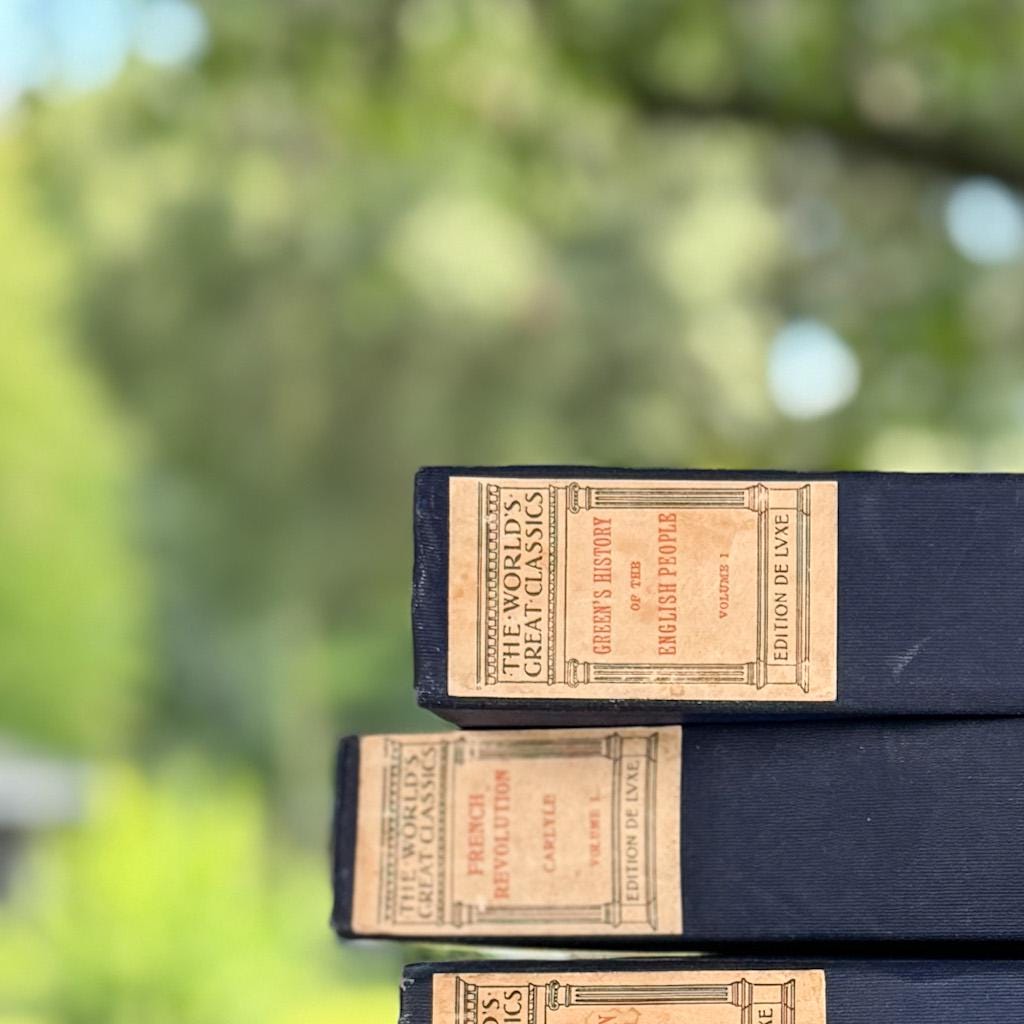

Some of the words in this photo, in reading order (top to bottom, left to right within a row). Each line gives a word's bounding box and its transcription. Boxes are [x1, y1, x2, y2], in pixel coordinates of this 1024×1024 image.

[525, 491, 543, 596] CLASSICS
[593, 517, 612, 583] HISTORY
[659, 512, 677, 576] PEOPLE
[773, 563, 789, 585] DE
[592, 589, 612, 654] GREEN'S
[630, 593, 641, 611] OF
[658, 583, 677, 655] ENGLISH
[719, 564, 729, 618] VOLUME
[502, 624, 521, 673] THE
[524, 605, 542, 677] GREAT
[773, 592, 789, 661] EDITION
[467, 794, 484, 876] FRENCH
[493, 769, 511, 899] REVOLUTION
[544, 794, 556, 873] CARLYLE
[626, 809, 639, 829] DE
[625, 835, 639, 901] EDITION
